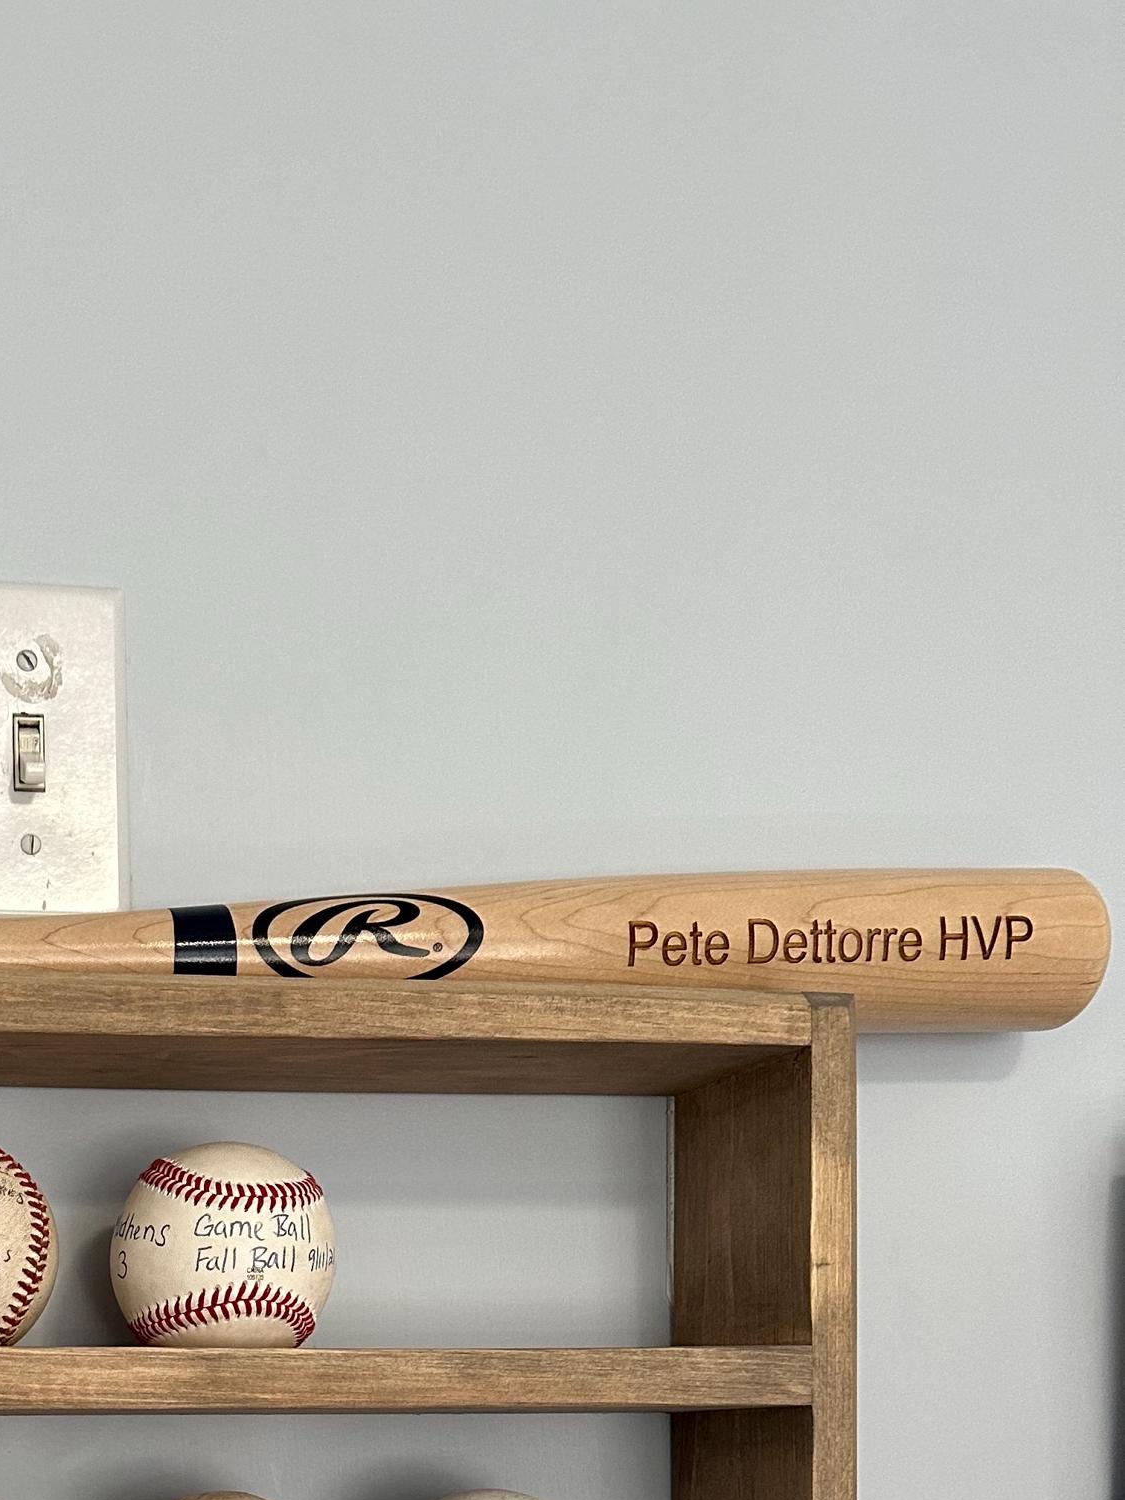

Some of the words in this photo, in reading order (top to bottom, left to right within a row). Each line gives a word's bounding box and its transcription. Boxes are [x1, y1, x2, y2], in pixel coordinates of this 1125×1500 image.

[628, 917, 730, 968] Pete
[747, 916, 923, 966] Dettorre
[938, 914, 1035, 962] HVP
[193, 1213, 266, 1241] Game
[272, 1213, 312, 1244] Ball
[117, 1250, 128, 1280] 3
[194, 1246, 237, 1274] Fall
[251, 1245, 297, 1273] Ball
